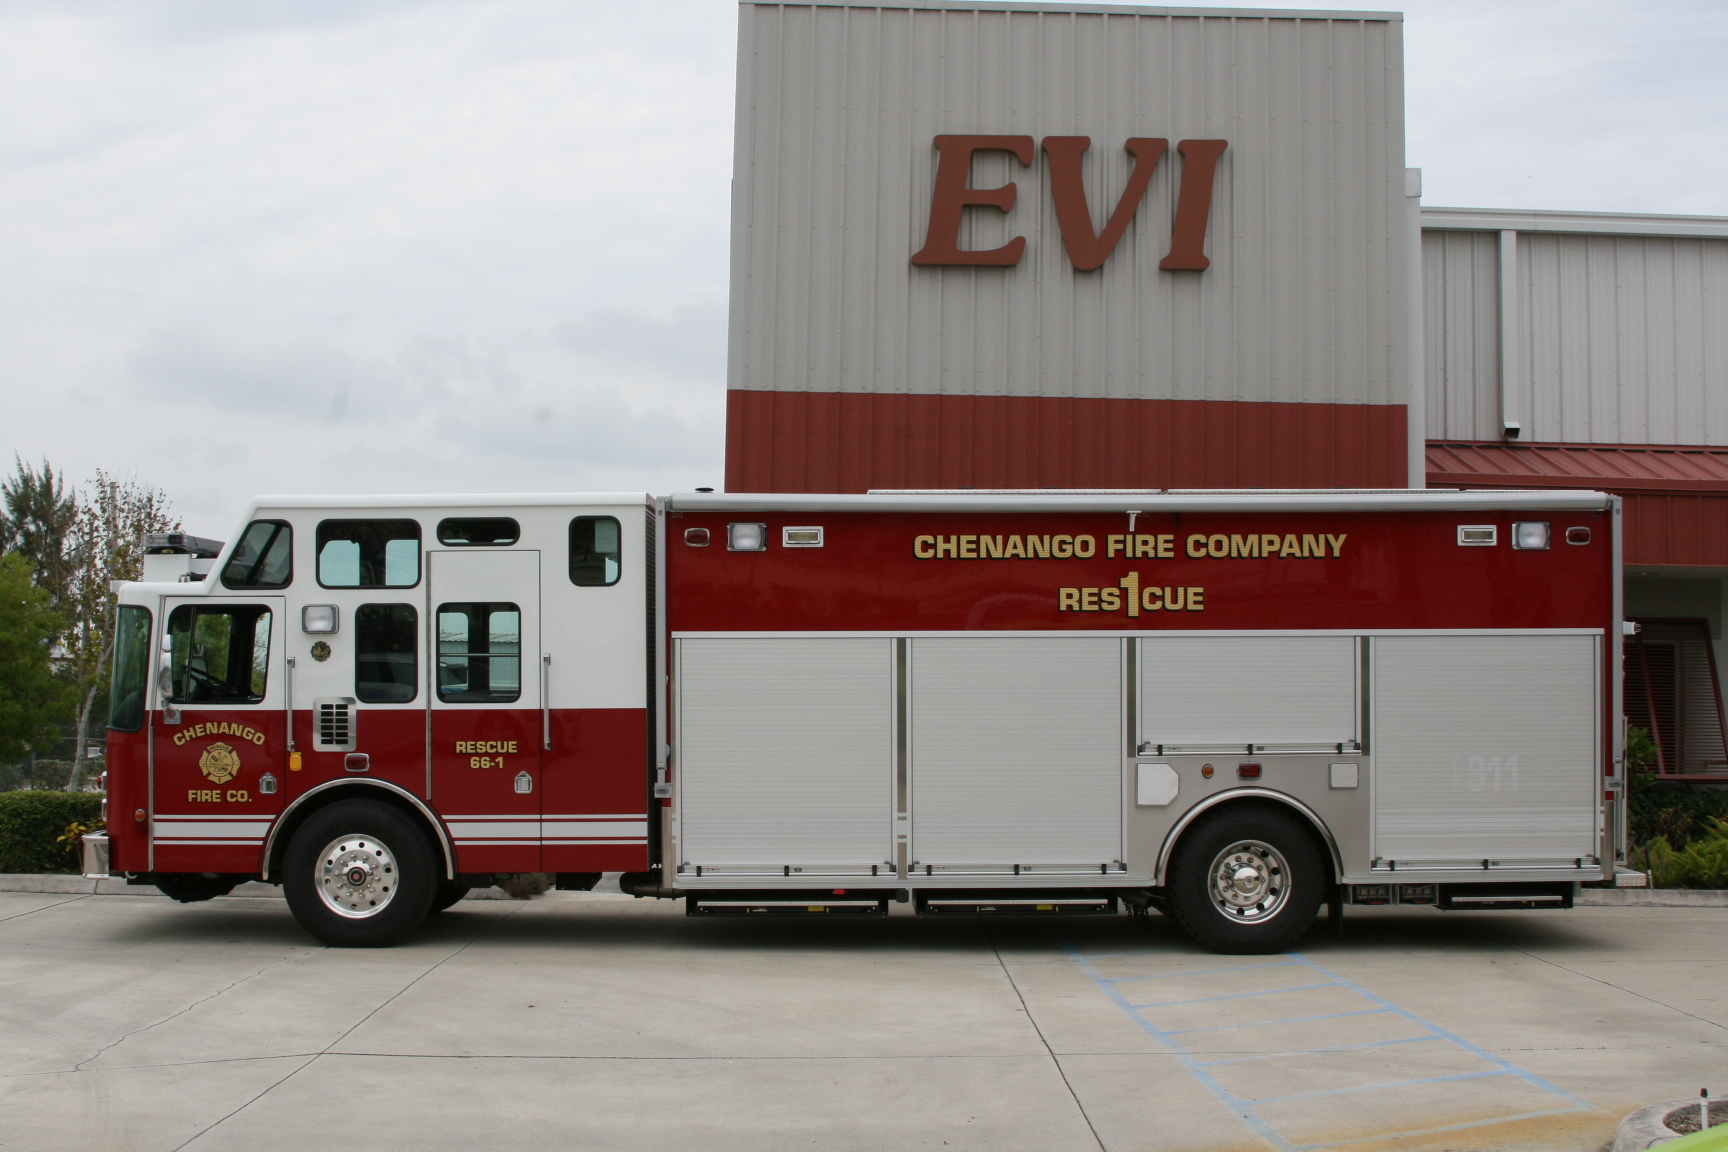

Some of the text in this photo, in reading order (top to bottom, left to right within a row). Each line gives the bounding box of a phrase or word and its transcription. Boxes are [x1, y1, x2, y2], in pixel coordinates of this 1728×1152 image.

[911, 135, 1228, 271] EVI
[913, 533, 1347, 559] CHENANGO FIRE COMPANY
[173, 722, 266, 746] CHENANGO
[456, 741, 518, 753] RESCUE
[470, 756, 504, 769] 66-1
[1467, 755, 1518, 792] 911
[188, 790, 252, 802] FIRE CO.
